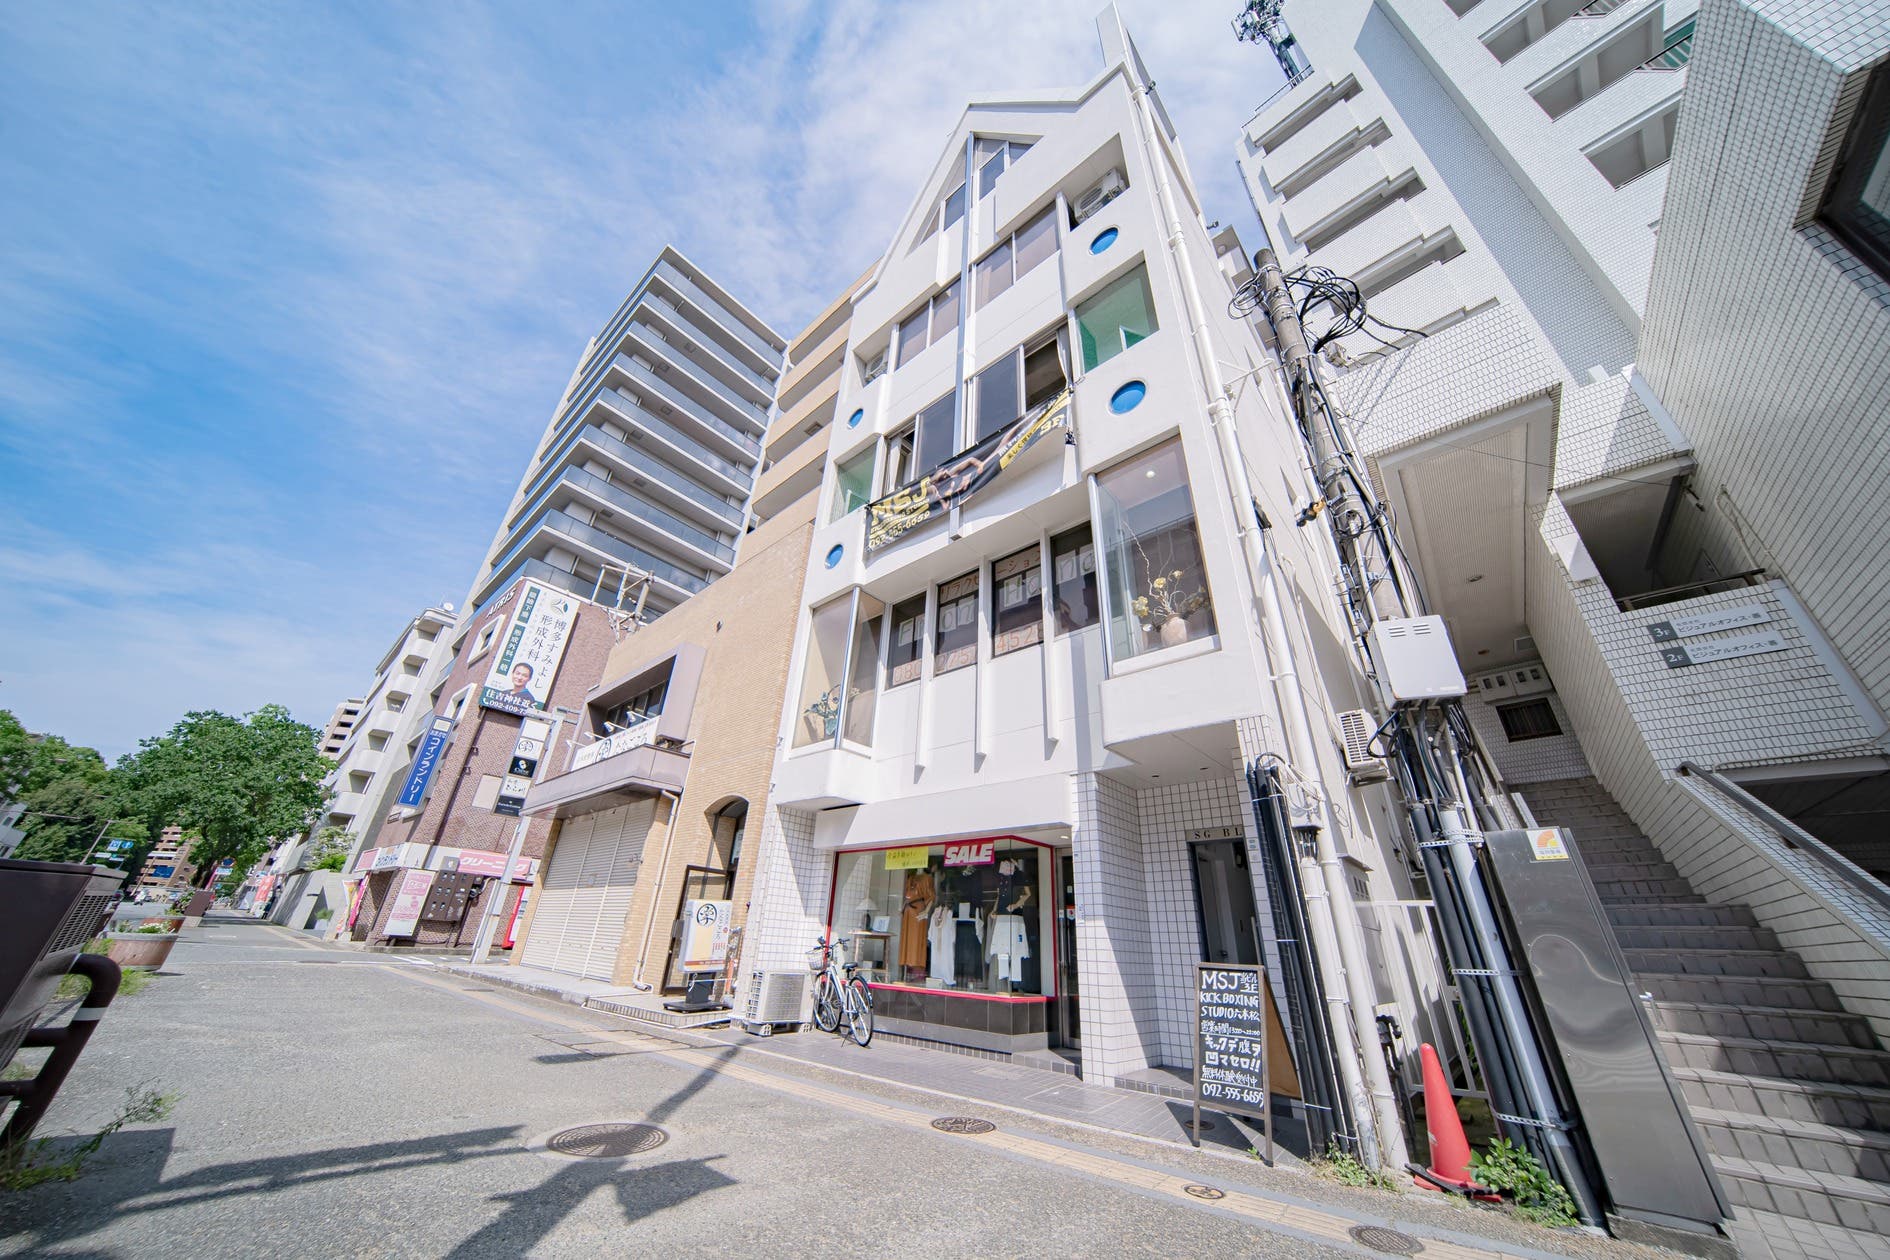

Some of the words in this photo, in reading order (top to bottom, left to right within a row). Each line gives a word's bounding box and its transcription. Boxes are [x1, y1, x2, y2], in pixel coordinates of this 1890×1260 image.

[871, 476, 930, 526] MSJ
[527, 615, 553, 662] 形成外科
[1654, 627, 1670, 638] 3F
[534, 619, 567, 689] 博多すみよし
[1667, 653, 1684, 664] 2F
[486, 688, 538, 710] 住吉神社近く
[409, 736, 440, 802] コインランドリー
[1194, 830, 1211, 839] SG
[945, 843, 994, 865] SALE
[1202, 970, 1241, 990] MSJ
[1200, 991, 1222, 1004] KICK
[1223, 992, 1259, 1007] BOXING
